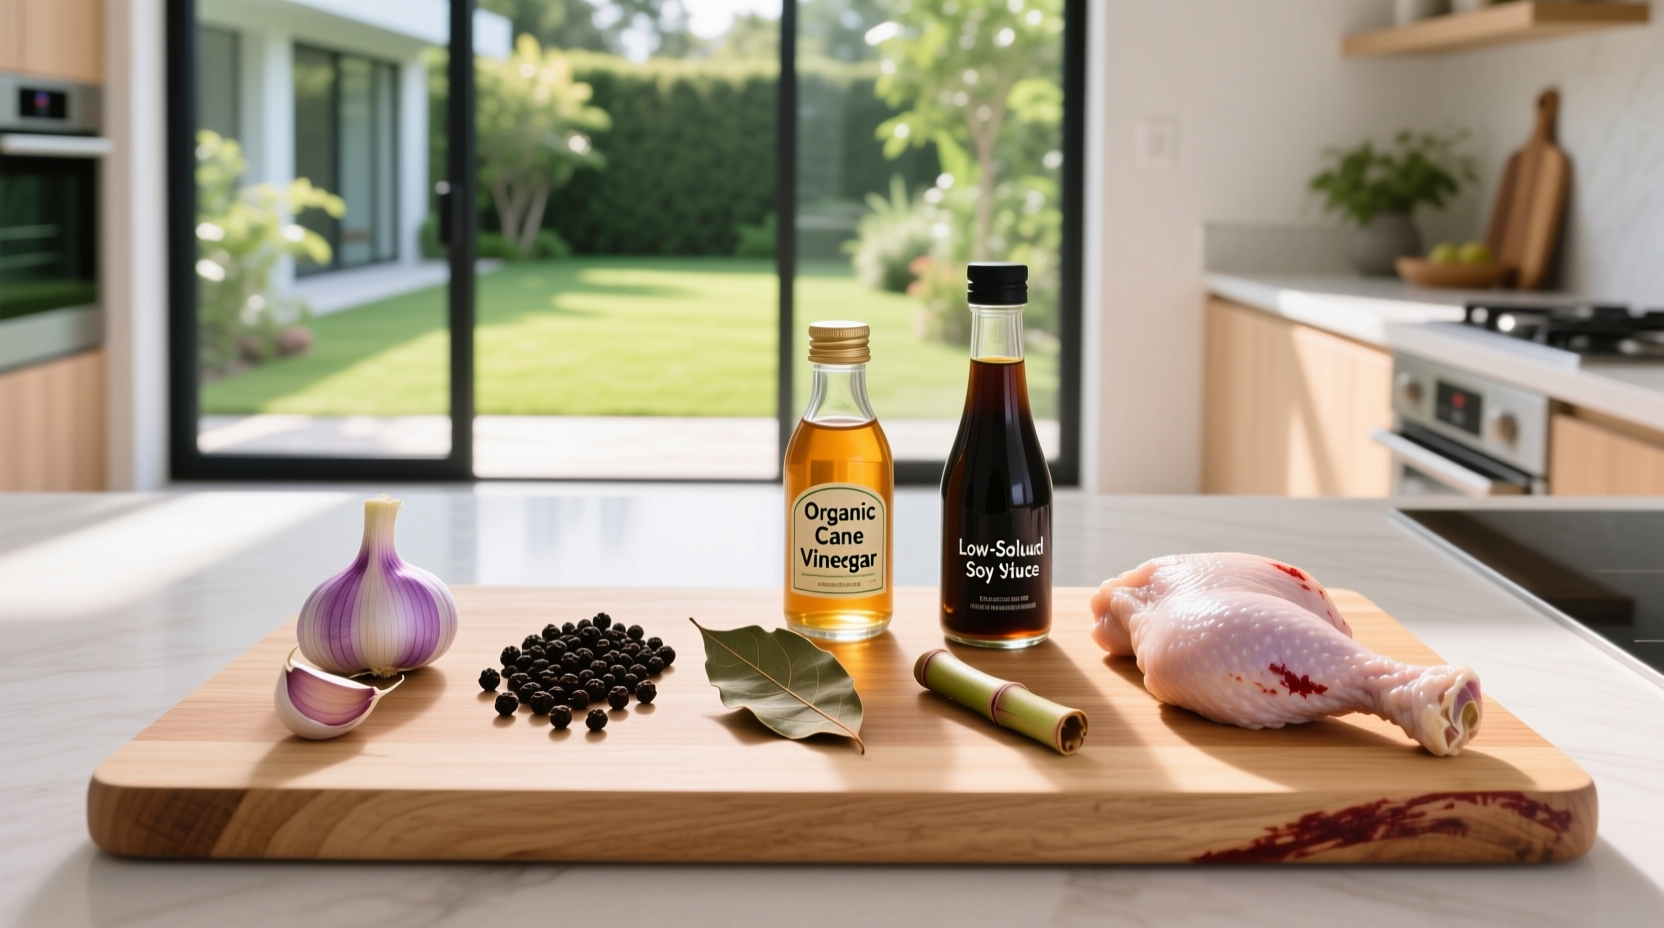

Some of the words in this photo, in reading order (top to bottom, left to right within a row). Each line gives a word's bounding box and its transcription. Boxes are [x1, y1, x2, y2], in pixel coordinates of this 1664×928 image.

[804, 501, 876, 526] Organic
[814, 526, 864, 545] Cane
[965, 561, 994, 584] Soy
